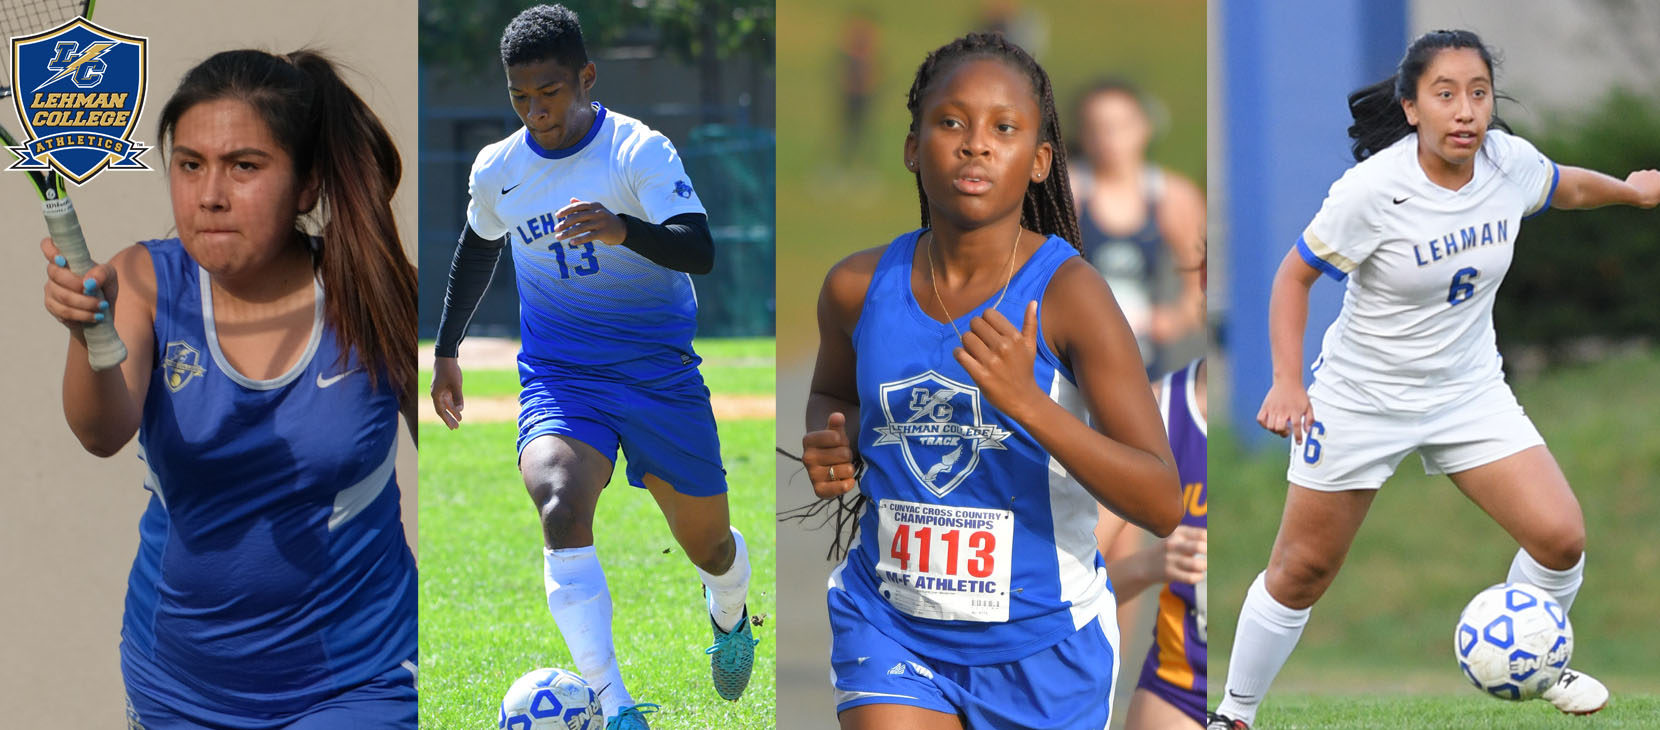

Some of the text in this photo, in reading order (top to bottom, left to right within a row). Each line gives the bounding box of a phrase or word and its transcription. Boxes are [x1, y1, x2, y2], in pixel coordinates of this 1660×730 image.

[516, 212, 577, 245] LEH
[1413, 219, 1508, 267] LEHMAN
[548, 241, 600, 280] 13
[1447, 266, 1479, 306] 6
[892, 423, 940, 434] LEHMAN
[919, 437, 961, 446] TRACK
[1303, 420, 1326, 466] 6
[889, 503, 1002, 521] CUNYAC CROSS COUNTRY
[894, 512, 994, 530] CHAMPIONSHIPS
[890, 524, 996, 579] 4113
[914, 576, 997, 594] ATHLETIC
